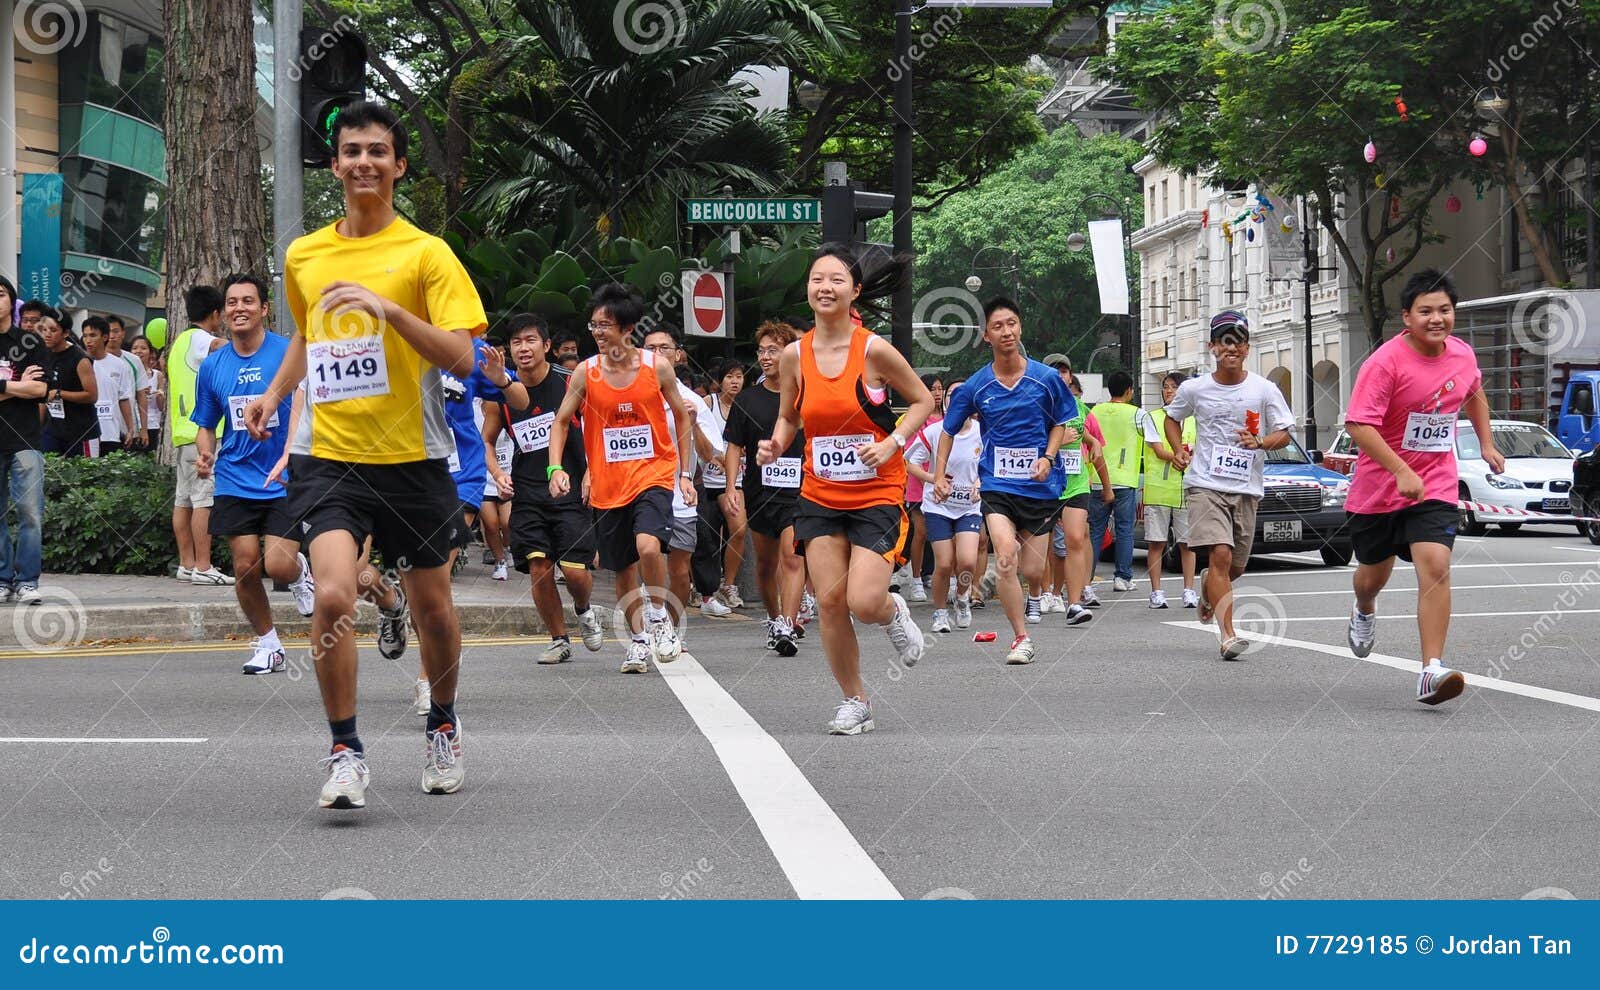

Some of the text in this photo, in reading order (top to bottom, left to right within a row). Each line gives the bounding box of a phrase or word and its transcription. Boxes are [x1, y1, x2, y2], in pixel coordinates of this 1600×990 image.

[692, 202, 812, 220] BENCOOLEN ST
[41, 267, 49, 302] NOMICS
[316, 358, 378, 382] 1149
[238, 373, 261, 384] SYOG
[99, 406, 110, 414] 69
[1412, 426, 1449, 440] 1045
[610, 437, 647, 450] 0869
[819, 450, 857, 467] 094
[1000, 458, 1034, 469] 1147
[1216, 455, 1248, 471] 1544
[765, 466, 797, 478] 0949
[949, 490, 970, 501] 464
[1273, 522, 1293, 531] SHA
[1265, 531, 1300, 541] 2592U
